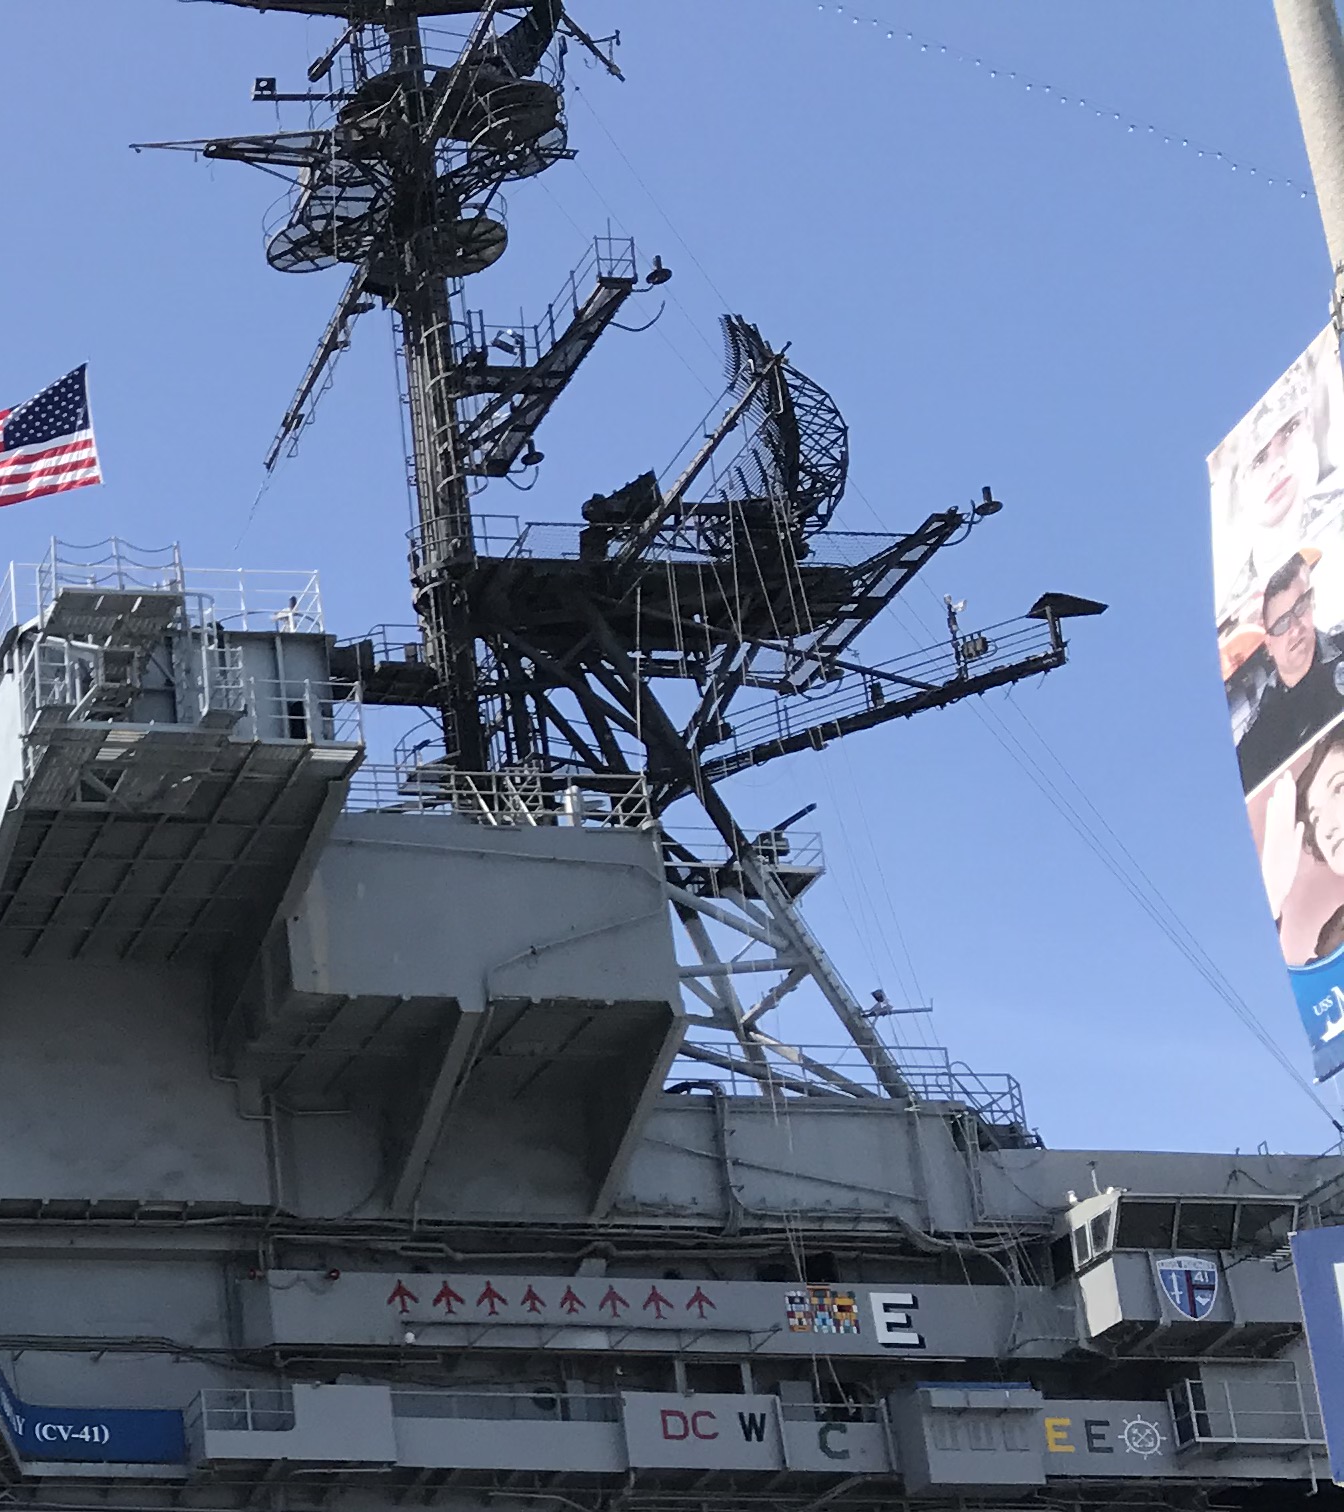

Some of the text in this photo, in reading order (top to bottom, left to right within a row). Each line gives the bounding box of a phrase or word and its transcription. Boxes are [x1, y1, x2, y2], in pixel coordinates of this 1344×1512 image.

[1313, 994, 1334, 1017] USS
[869, 1292, 926, 1349] E
[34, 1422, 111, 1446] (CV-41)
[660, 1409, 1114, 1460] DC W C E E
